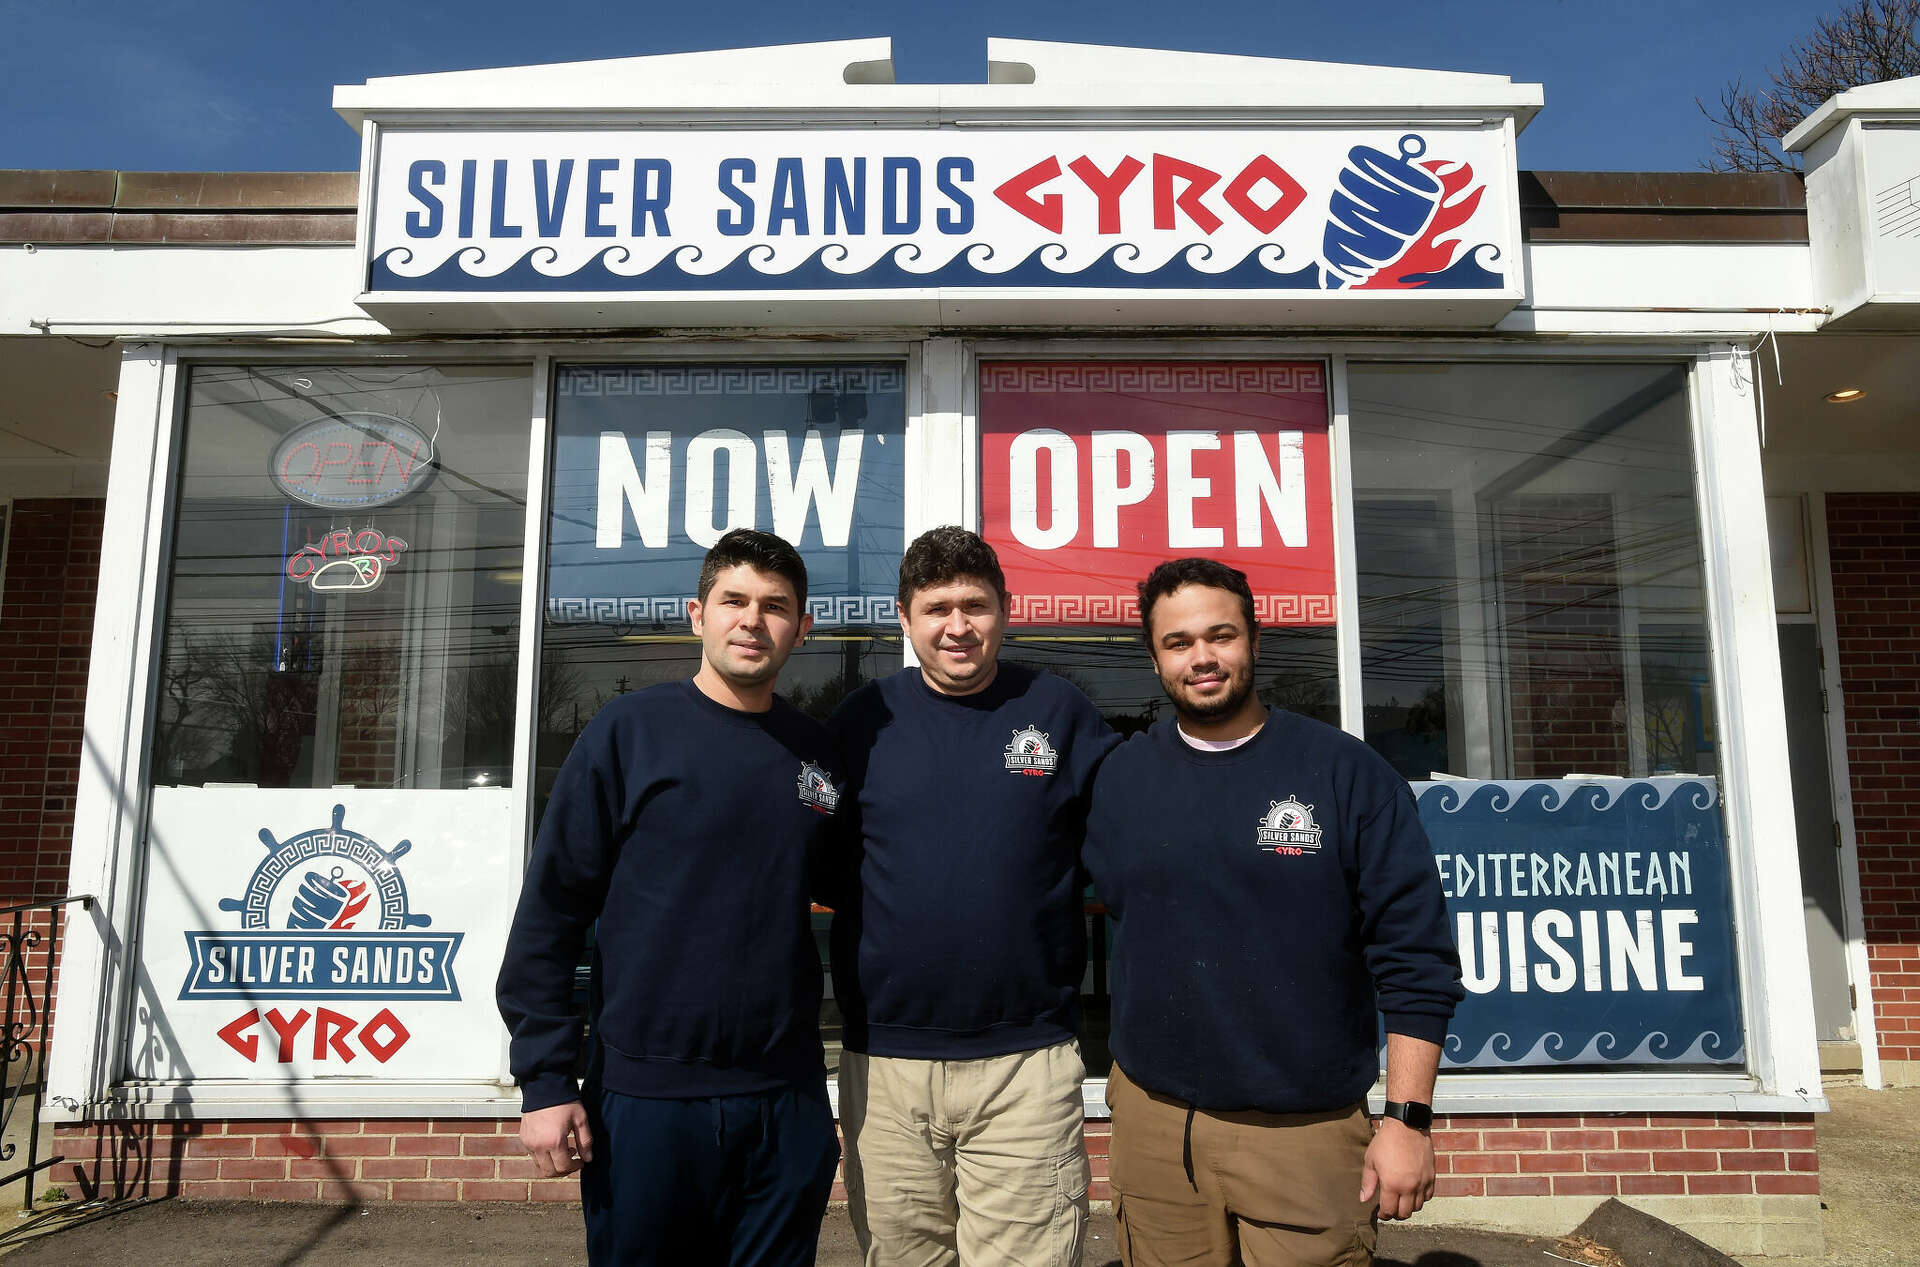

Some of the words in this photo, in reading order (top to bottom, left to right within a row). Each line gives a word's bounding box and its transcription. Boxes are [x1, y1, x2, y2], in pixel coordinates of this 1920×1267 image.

[406, 159, 672, 238] SILVER
[717, 156, 975, 236] SANDS
[993, 152, 1307, 235] GYRO
[281, 441, 422, 486] OPEN
[595, 428, 864, 548] NOW
[1009, 427, 1308, 549] OPEN
[1263, 831, 1288, 841] SILVER
[1290, 832, 1315, 843] SANDS
[1275, 846, 1303, 856] GYRO
[1436, 851, 1692, 897] EDITERRANEAN
[208, 946, 315, 983] SILVER
[331, 946, 434, 984] SANDS
[1456, 909, 1704, 994] UISINE
[216, 1006, 411, 1064] GYRO
